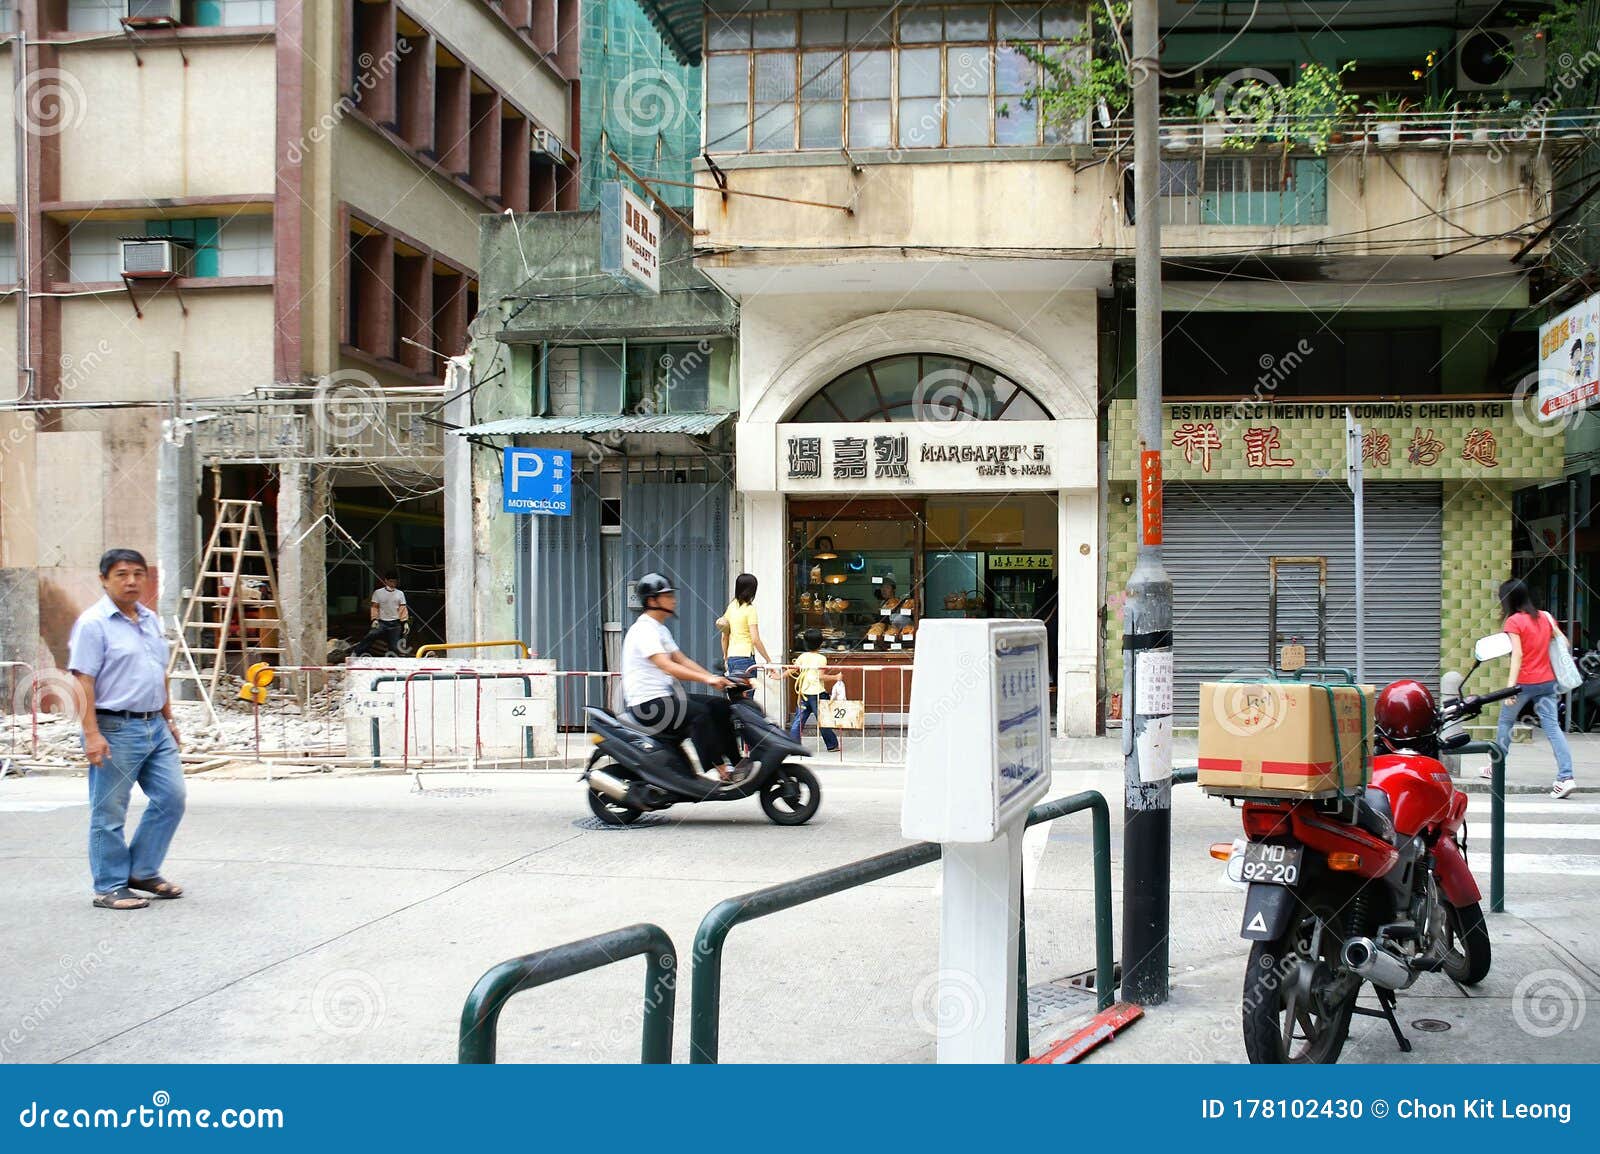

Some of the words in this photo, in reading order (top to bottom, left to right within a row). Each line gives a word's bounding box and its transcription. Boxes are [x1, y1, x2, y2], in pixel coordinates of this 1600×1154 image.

[1171, 404, 1324, 420] ESTABELECIMENTO
[1329, 404, 1347, 419] DE
[1355, 404, 1413, 419] COMIDAS
[1419, 403, 1476, 418] CHEING
[1482, 403, 1504, 418] KEI
[920, 442, 1045, 464] MARGARET'S
[1172, 423, 1295, 472] 祥記
[511, 452, 544, 493] P
[552, 455, 564, 494] 電單車
[508, 499, 567, 509] MOTOCICLOS
[512, 704, 527, 716] 62
[833, 707, 846, 720] 29
[1260, 844, 1285, 862] MD
[1244, 862, 1297, 883] 92-20
